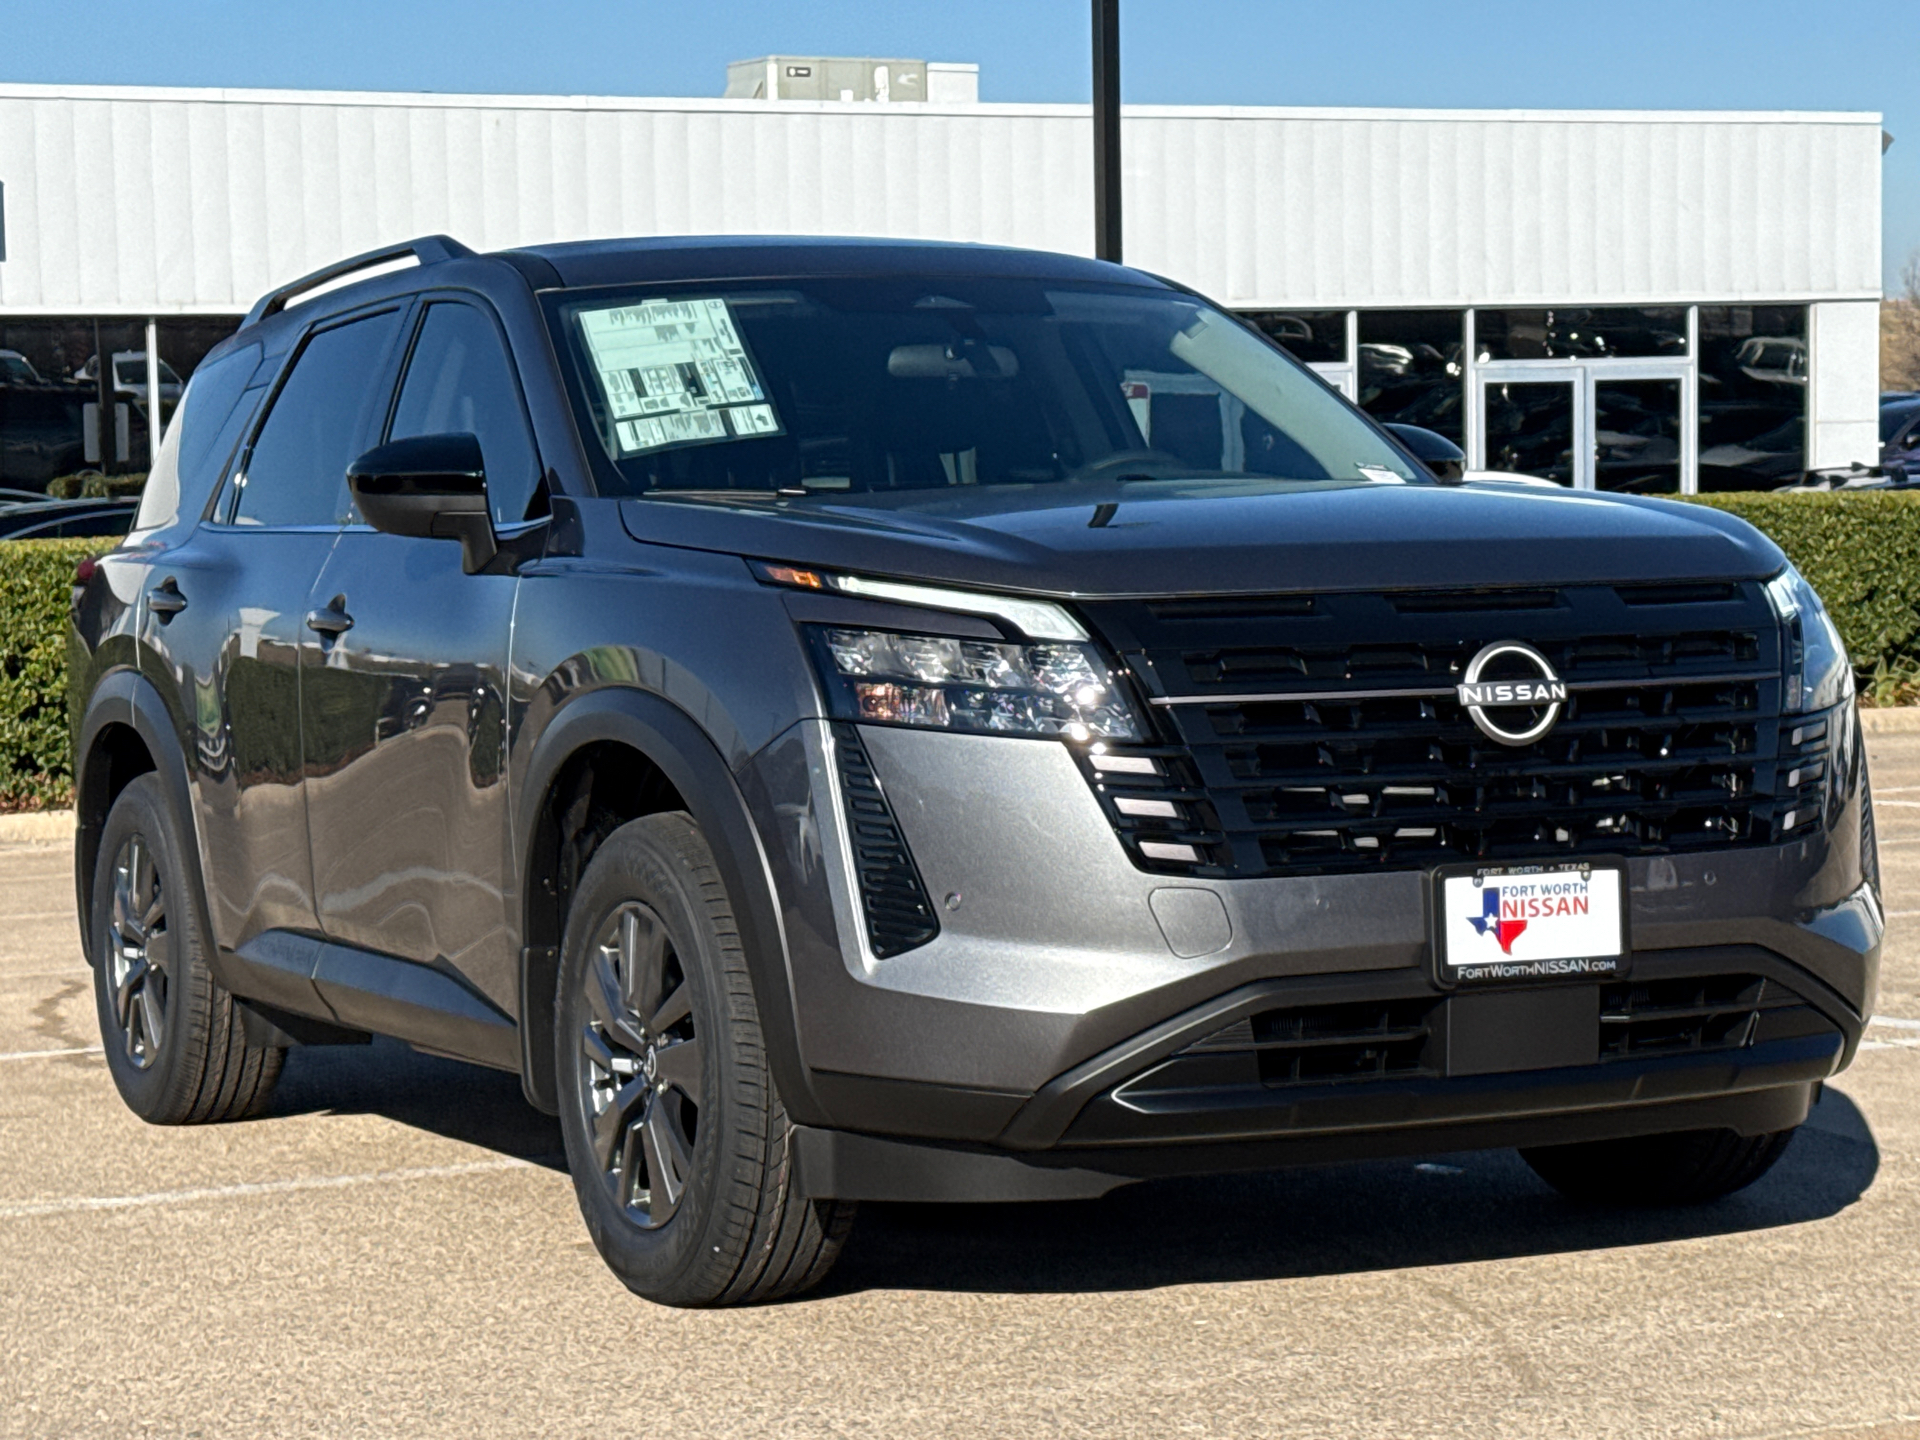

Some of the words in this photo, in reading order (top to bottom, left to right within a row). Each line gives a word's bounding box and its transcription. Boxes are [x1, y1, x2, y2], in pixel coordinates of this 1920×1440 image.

[1462, 684, 1566, 703] NISSAN
[1477, 867, 1504, 876] FORT
[1508, 865, 1544, 875] WORTH
[1558, 862, 1590, 872] TEXAS
[1502, 885, 1536, 897] FORT
[1540, 882, 1588, 895] WORTH
[1502, 896, 1589, 918] NISSAN
